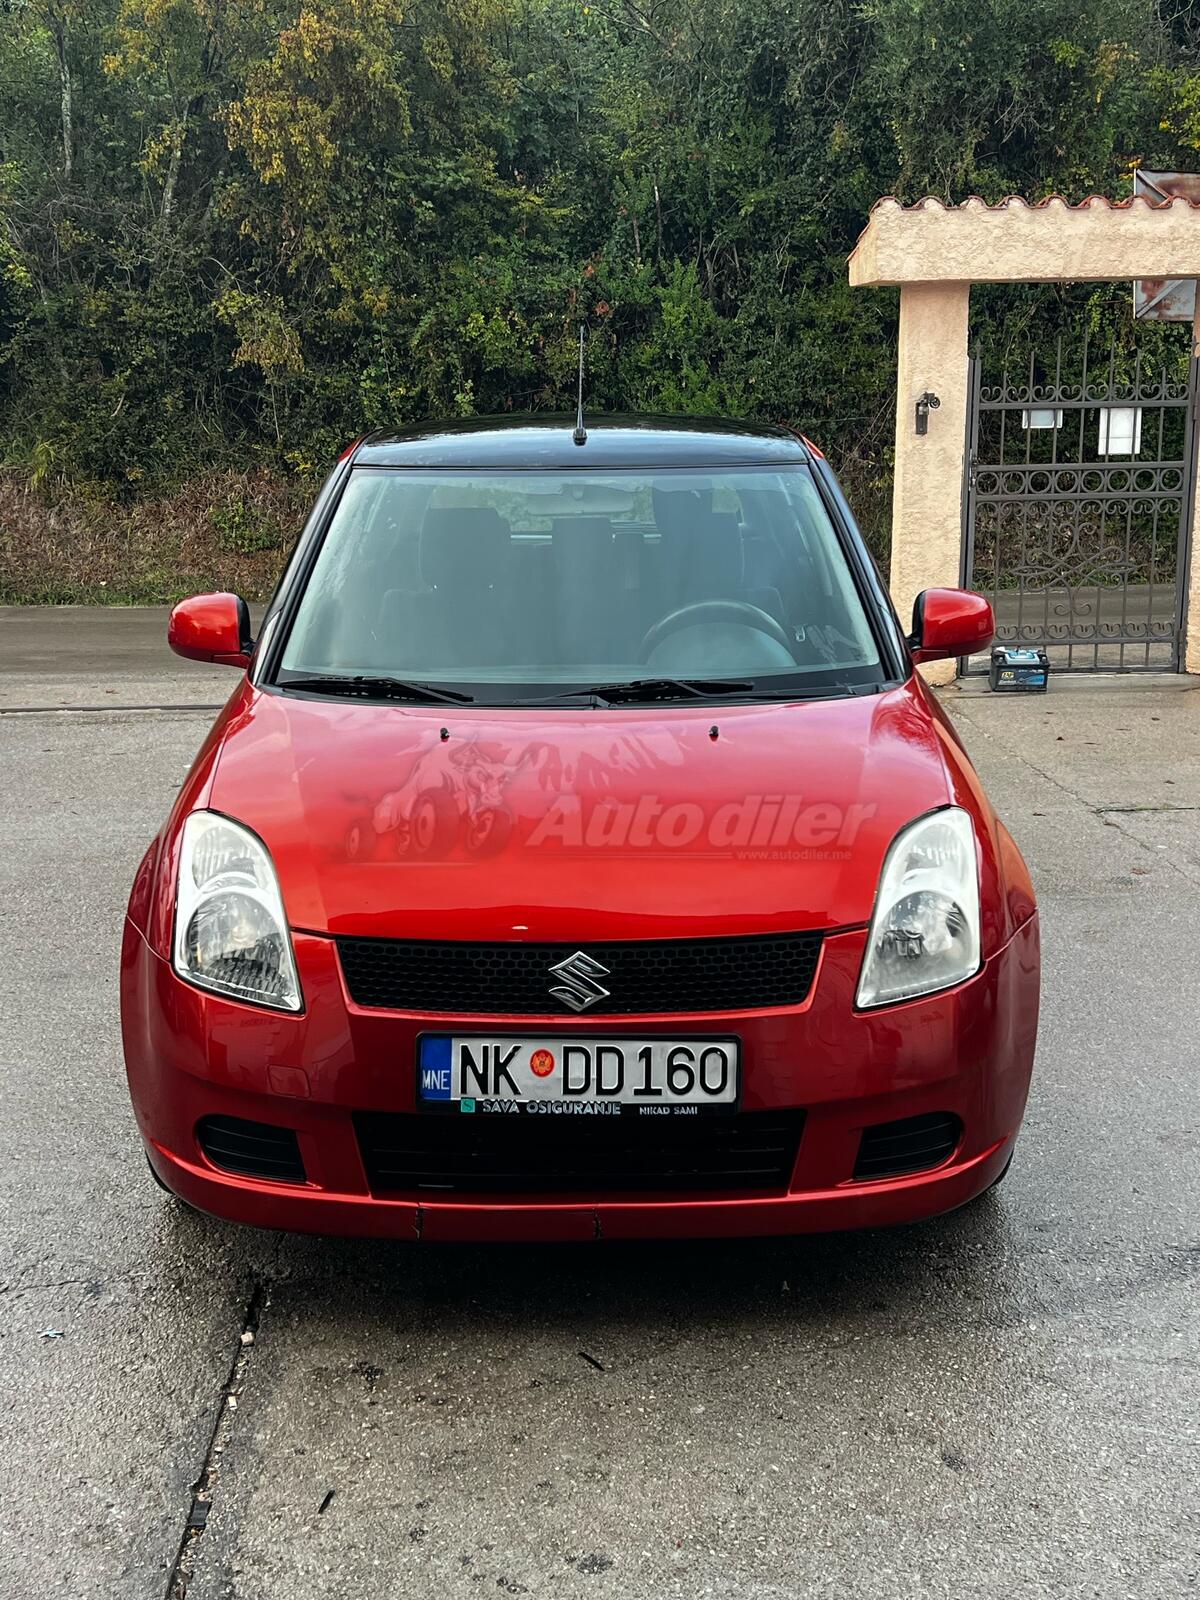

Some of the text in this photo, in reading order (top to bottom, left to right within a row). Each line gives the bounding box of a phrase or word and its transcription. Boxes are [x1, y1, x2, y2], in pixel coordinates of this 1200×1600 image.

[460, 1044, 522, 1096] NK
[422, 1069, 450, 1090] MNE
[482, 1100, 621, 1115] SAVA OSIGURANJE
[639, 1106, 698, 1116] NIKAD SAMI
